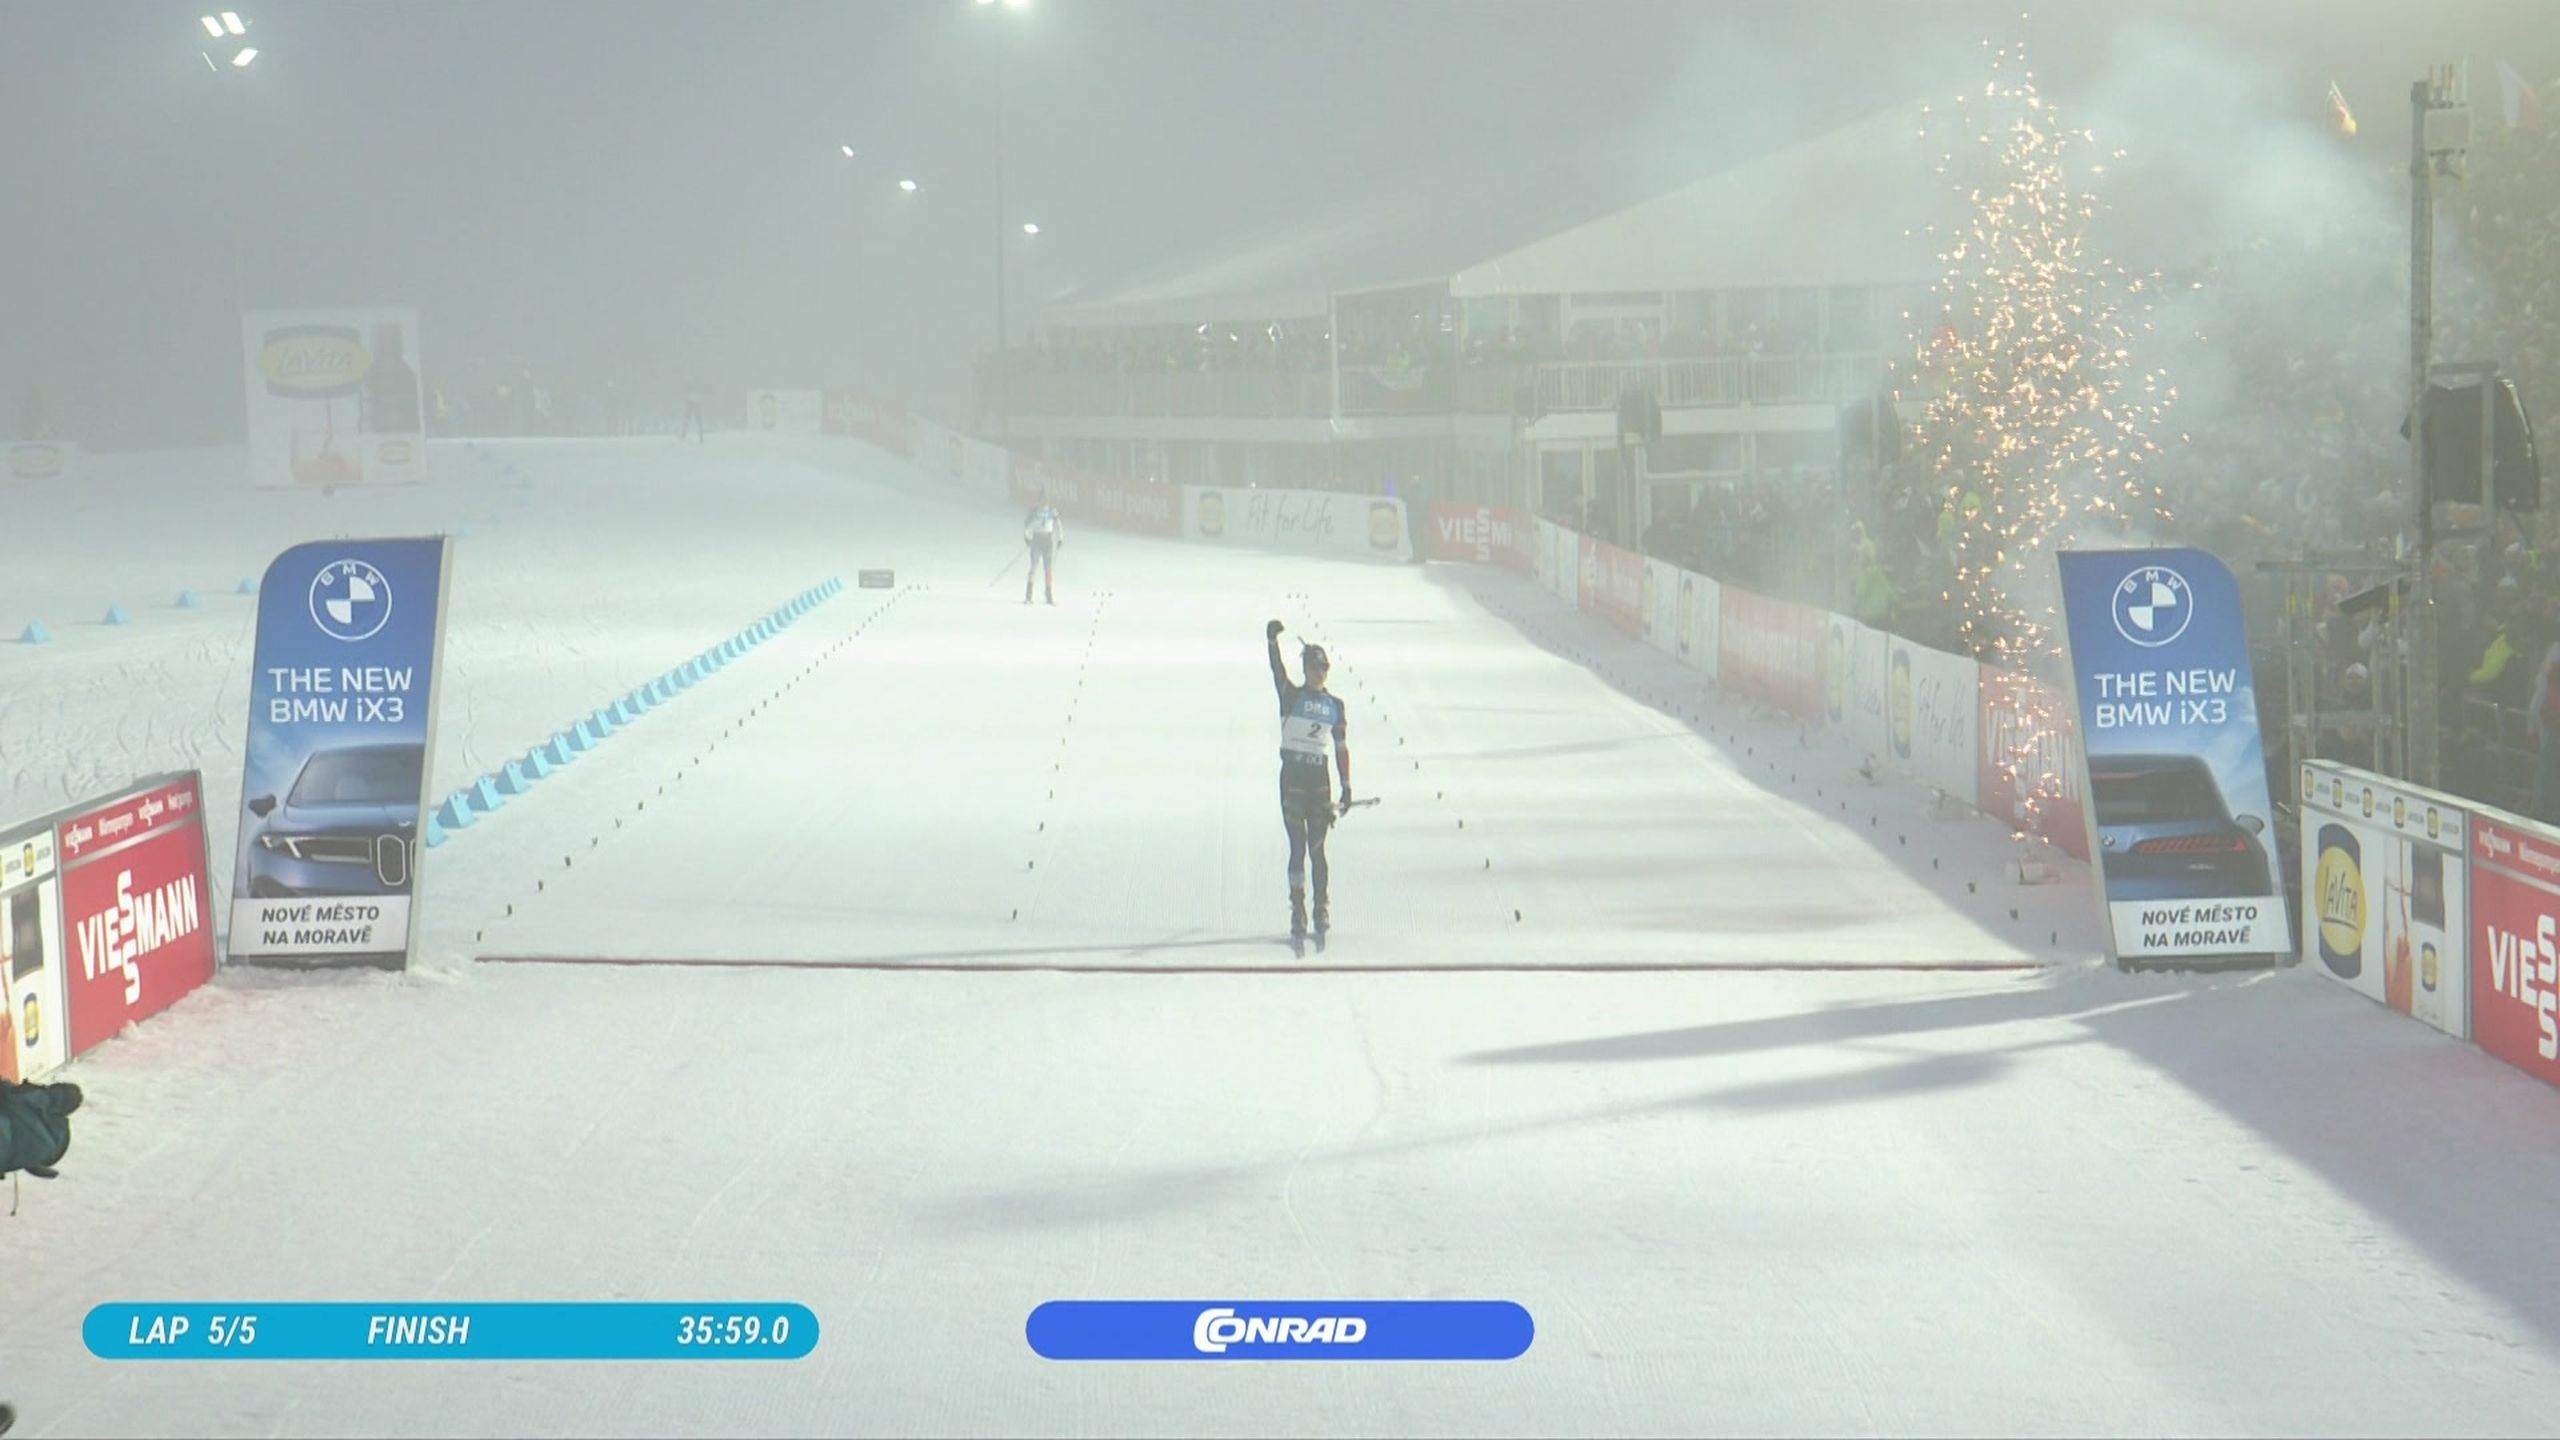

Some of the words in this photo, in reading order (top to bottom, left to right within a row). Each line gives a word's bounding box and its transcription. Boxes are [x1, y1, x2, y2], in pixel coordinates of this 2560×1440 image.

[1247, 492, 1269, 532] Fit
[1274, 493, 1300, 545] for
[1438, 506, 1515, 561] VIESSM
[320, 563, 380, 587] BMW
[2123, 569, 2182, 593] BMW
[268, 668, 332, 693] THE
[342, 667, 413, 693] NEW
[2094, 670, 2157, 698] THE
[2166, 668, 2237, 695] NEW
[270, 700, 348, 723] BMW
[356, 697, 405, 722] iX3
[2097, 702, 2173, 727] BMW
[2180, 699, 2227, 724] iX3
[1308, 723, 1322, 738] 2
[261, 904, 311, 923] NOVÉ
[315, 902, 380, 922] MĚSTO
[2141, 906, 2191, 925] NOVÉ
[2194, 904, 2258, 924] MĚSTO
[77, 869, 199, 1005] VIESSMANN
[262, 929, 289, 946] NA
[293, 925, 372, 945] MORAVĚ
[2143, 932, 2168, 948] NA
[2173, 925, 2251, 946] MORAVĚ
[2487, 913, 2560, 1061] VIESS
